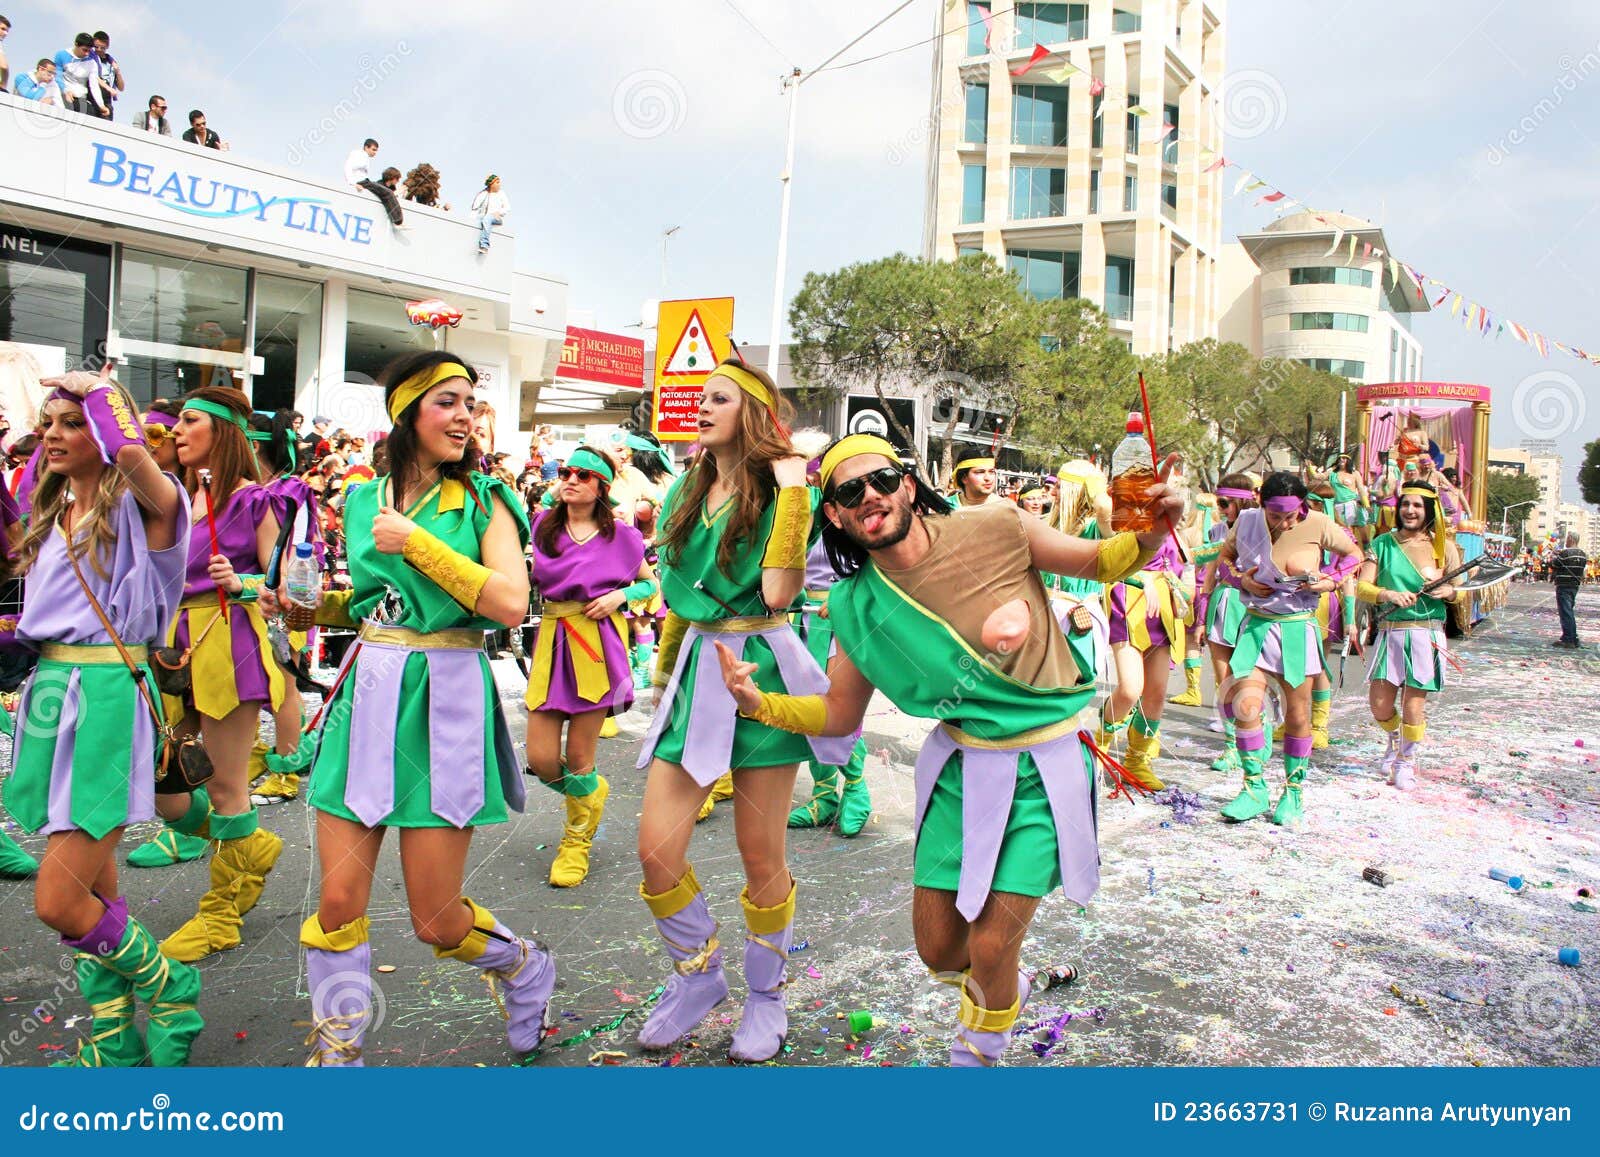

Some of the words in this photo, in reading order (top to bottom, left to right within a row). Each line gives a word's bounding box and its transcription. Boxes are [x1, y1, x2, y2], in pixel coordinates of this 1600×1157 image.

[2, 234, 44, 256] NEL
[586, 338, 642, 359] MICHAELIDES
[585, 355, 608, 367] HOME
[611, 359, 642, 373] TEXTILES
[665, 411, 686, 419] Pelican
